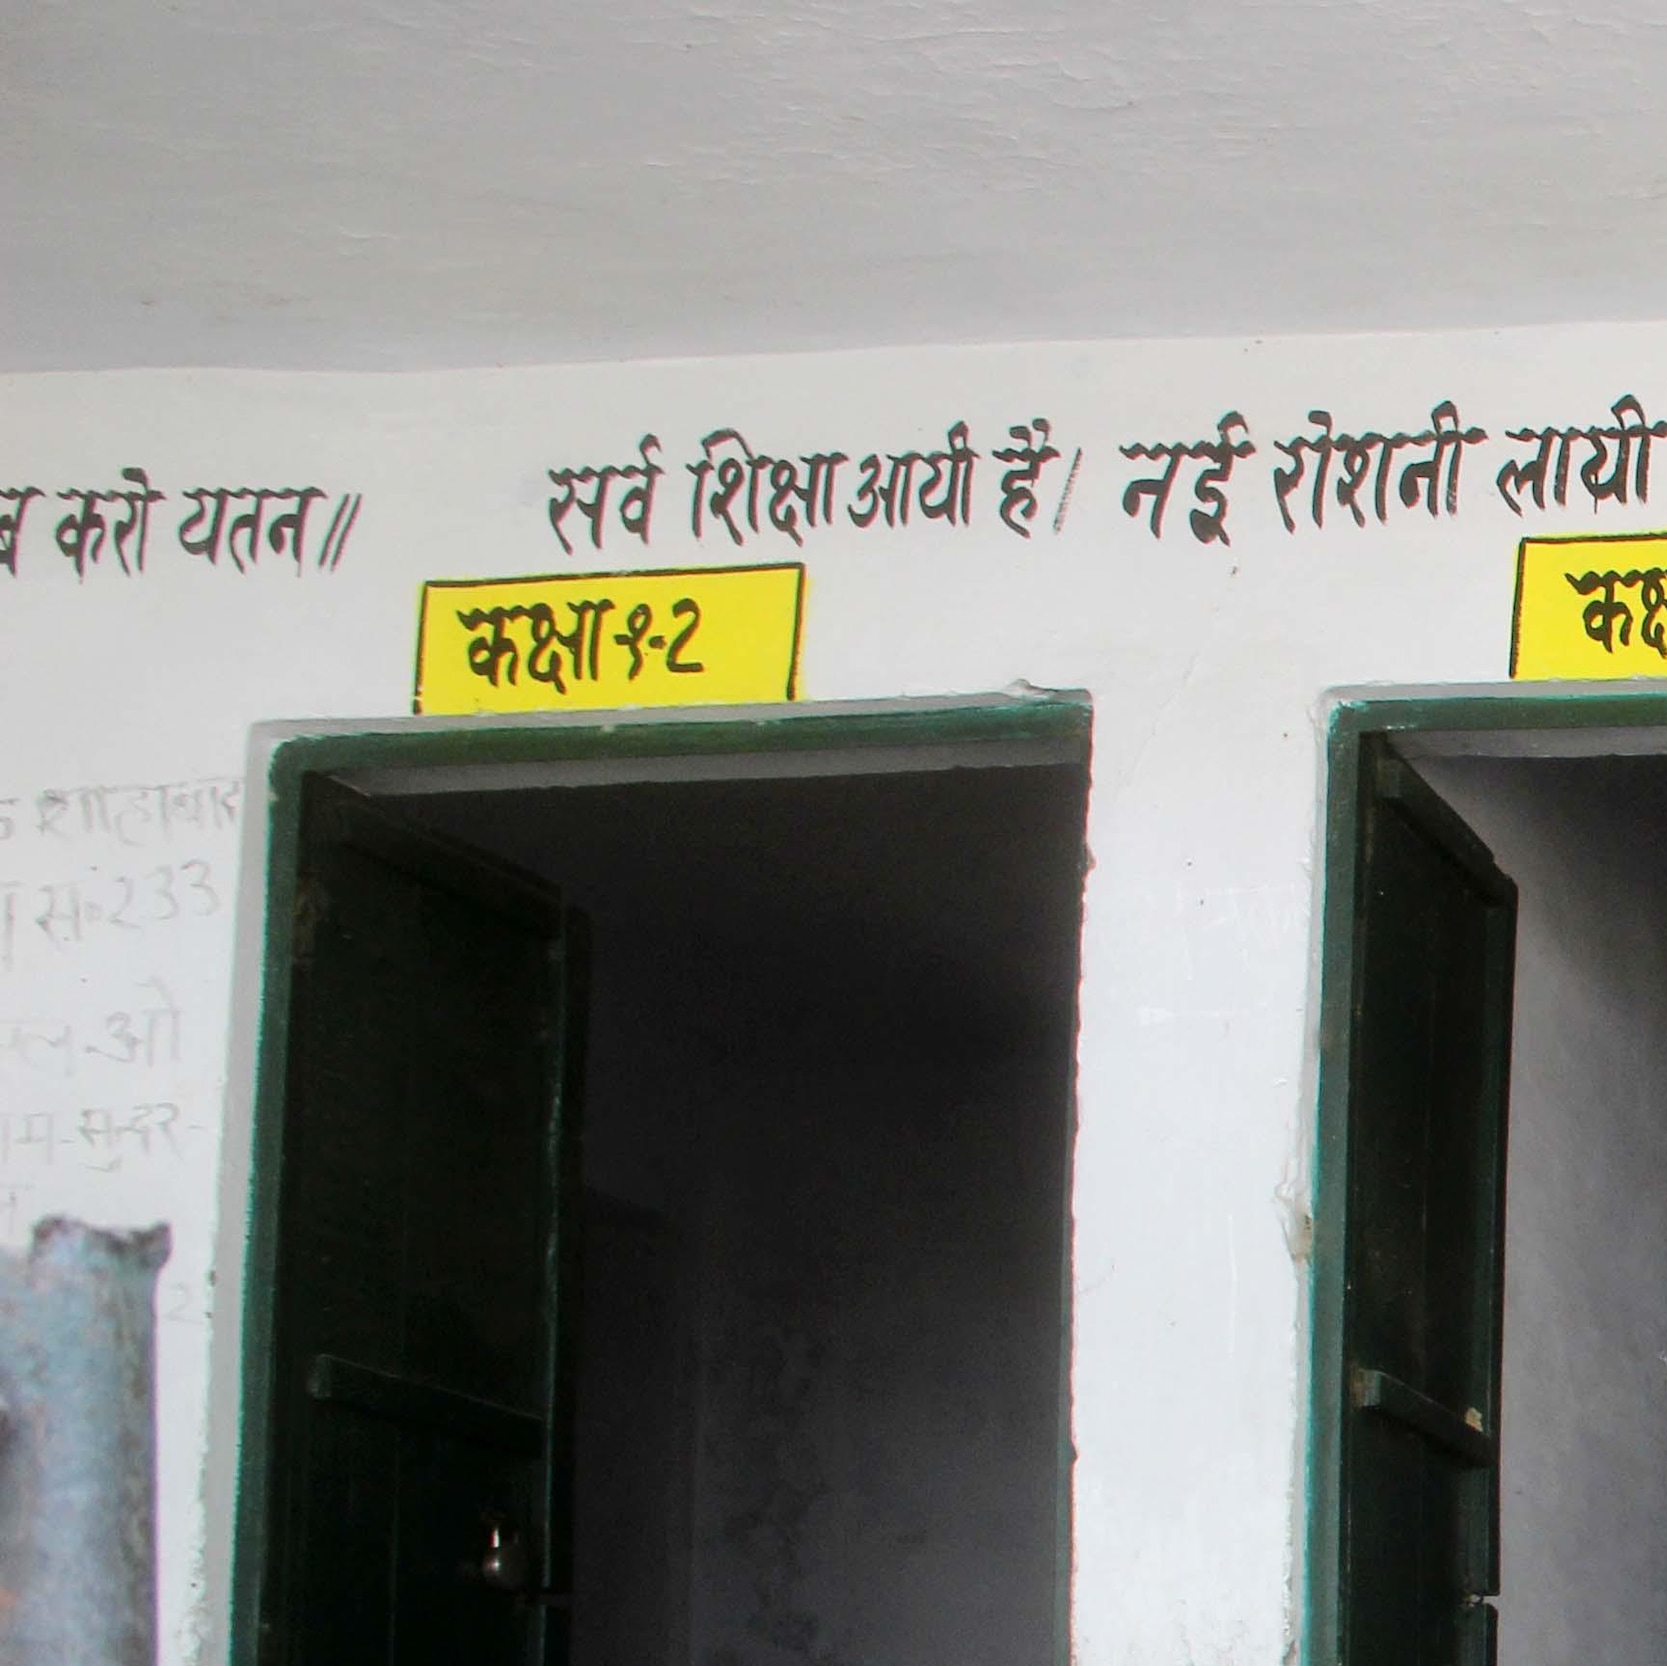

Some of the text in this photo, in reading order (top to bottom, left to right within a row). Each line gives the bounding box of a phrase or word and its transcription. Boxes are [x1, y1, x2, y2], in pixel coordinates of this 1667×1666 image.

[56, 466, 167, 584] करो
[549, 433, 666, 555] सर्व
[687, 429, 847, 547] शिक्षा
[847, 420, 979, 528] आयी
[1273, 400, 1489, 535] रोशनी
